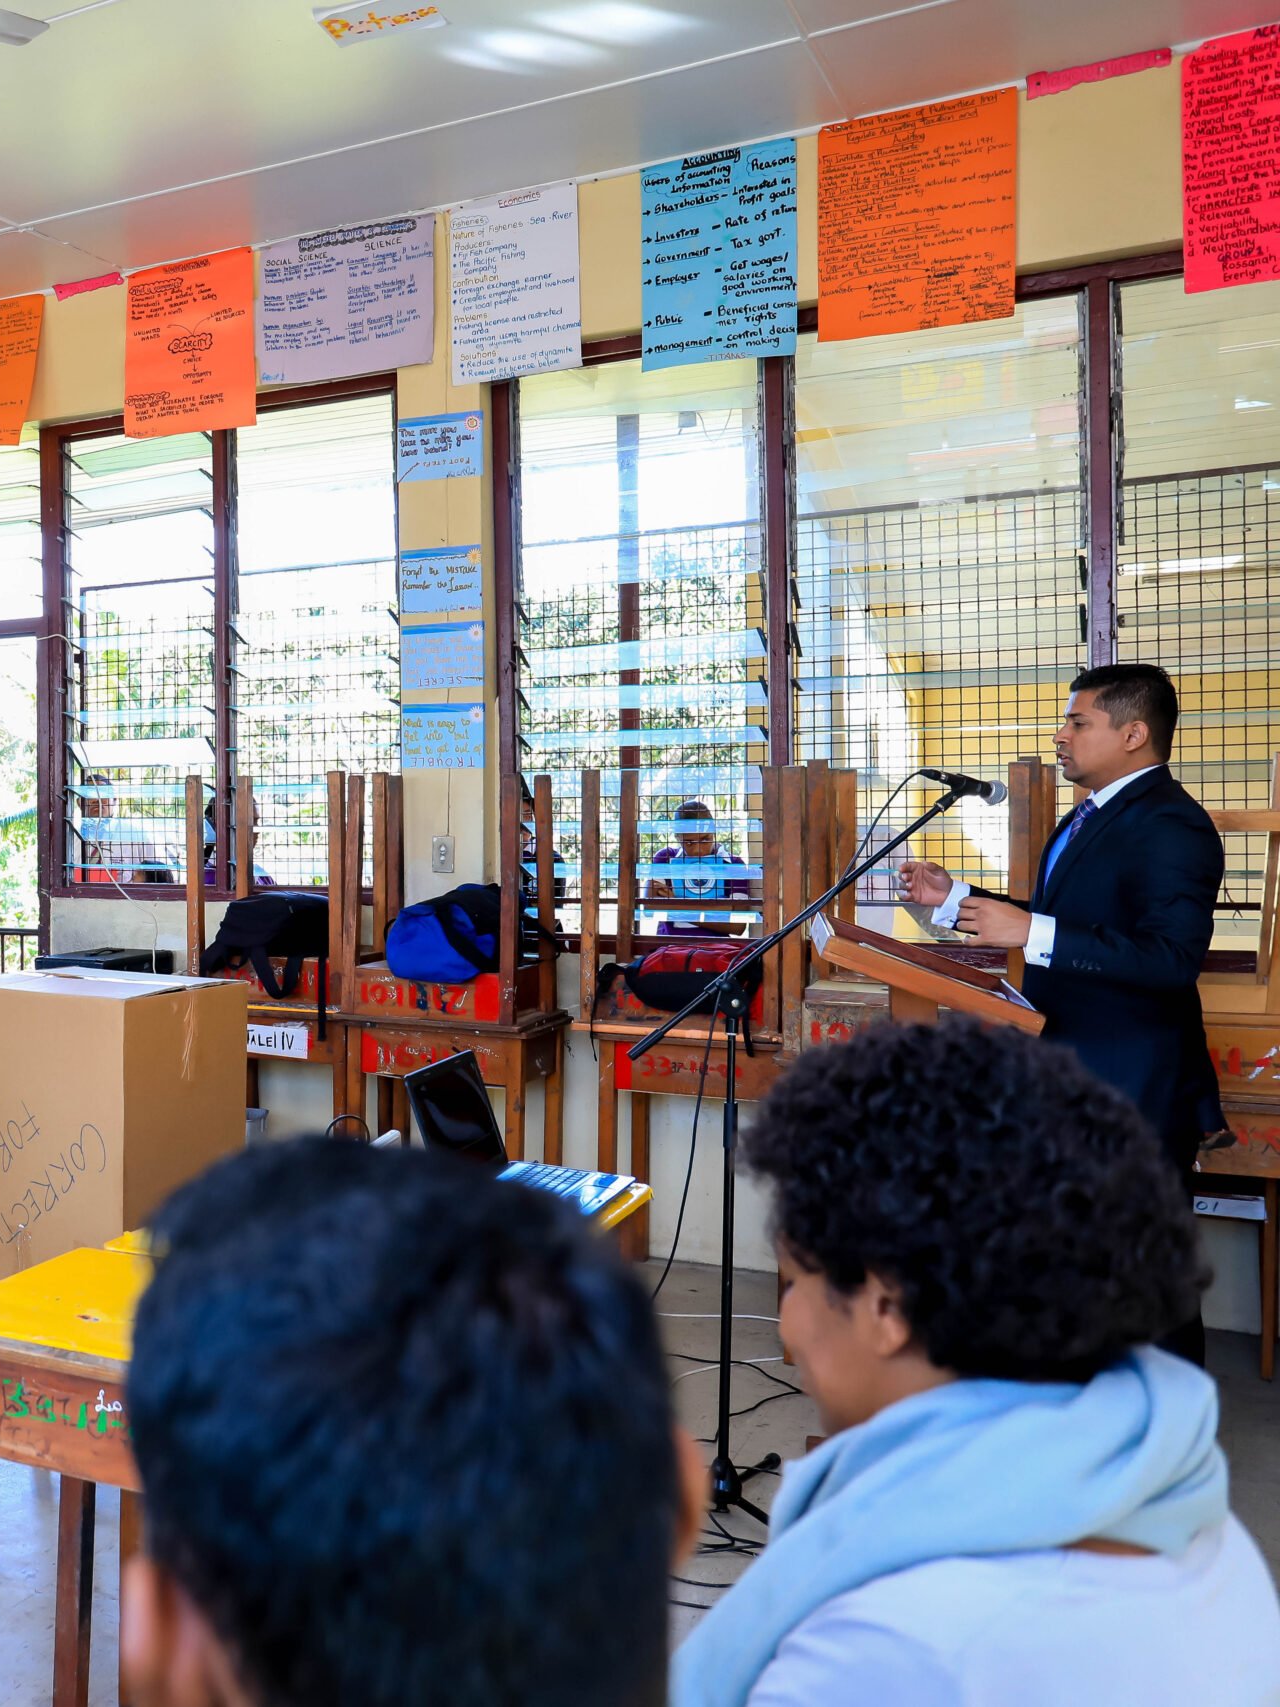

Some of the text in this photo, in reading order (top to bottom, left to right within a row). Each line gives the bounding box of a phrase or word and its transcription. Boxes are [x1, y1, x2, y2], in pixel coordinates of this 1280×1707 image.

[1198, 79, 1255, 94] accounting
[682, 148, 741, 169] ACCOUNTING
[751, 155, 796, 172] Reasons
[675, 165, 731, 182] of accounting
[671, 177, 731, 193] Information
[498, 191, 541, 206] Economics
[654, 177, 791, 214] Shareholders Interested in
[739, 195, 763, 206] Profit
[770, 187, 796, 203] goals
[1200, 207, 1250, 221] Relevance
[453, 231, 475, 240] Nature
[488, 221, 524, 233] Fisheries
[655, 209, 767, 241] Investors Rate of
[364, 237, 402, 251] SCIENCE
[470, 242, 517, 257] Fish Company
[655, 237, 752, 263] Government Tax
[1203, 239, 1255, 254] Neutrality
[266, 252, 328, 267] SOCIAL SCIENCE
[473, 256, 496, 267] Pacific
[501, 250, 526, 261] Fishing
[463, 265, 497, 275] Company
[655, 272, 700, 285] Employer
[730, 261, 748, 271] Get
[723, 270, 765, 282] salaries
[453, 274, 499, 288] Contribution
[458, 272, 552, 295] Foreign exchange earner
[722, 275, 793, 295] good working
[459, 282, 542, 305] Creates employment and
[735, 283, 797, 297] environment
[475, 301, 493, 309] local
[453, 312, 488, 323] Problems
[484, 317, 511, 326] license
[511, 314, 526, 322] and
[527, 307, 563, 319] restricted
[655, 302, 769, 326] Public Beneficial
[744, 312, 777, 327] rights
[459, 326, 550, 345] Fisherman using harmful
[746, 336, 780, 348] making
[173, 339, 208, 350] SCARCITY
[460, 350, 497, 361] Solutions
[466, 360, 494, 369] Reduce
[539, 346, 574, 359] dynamite
[418, 676, 462, 688] SECRET
